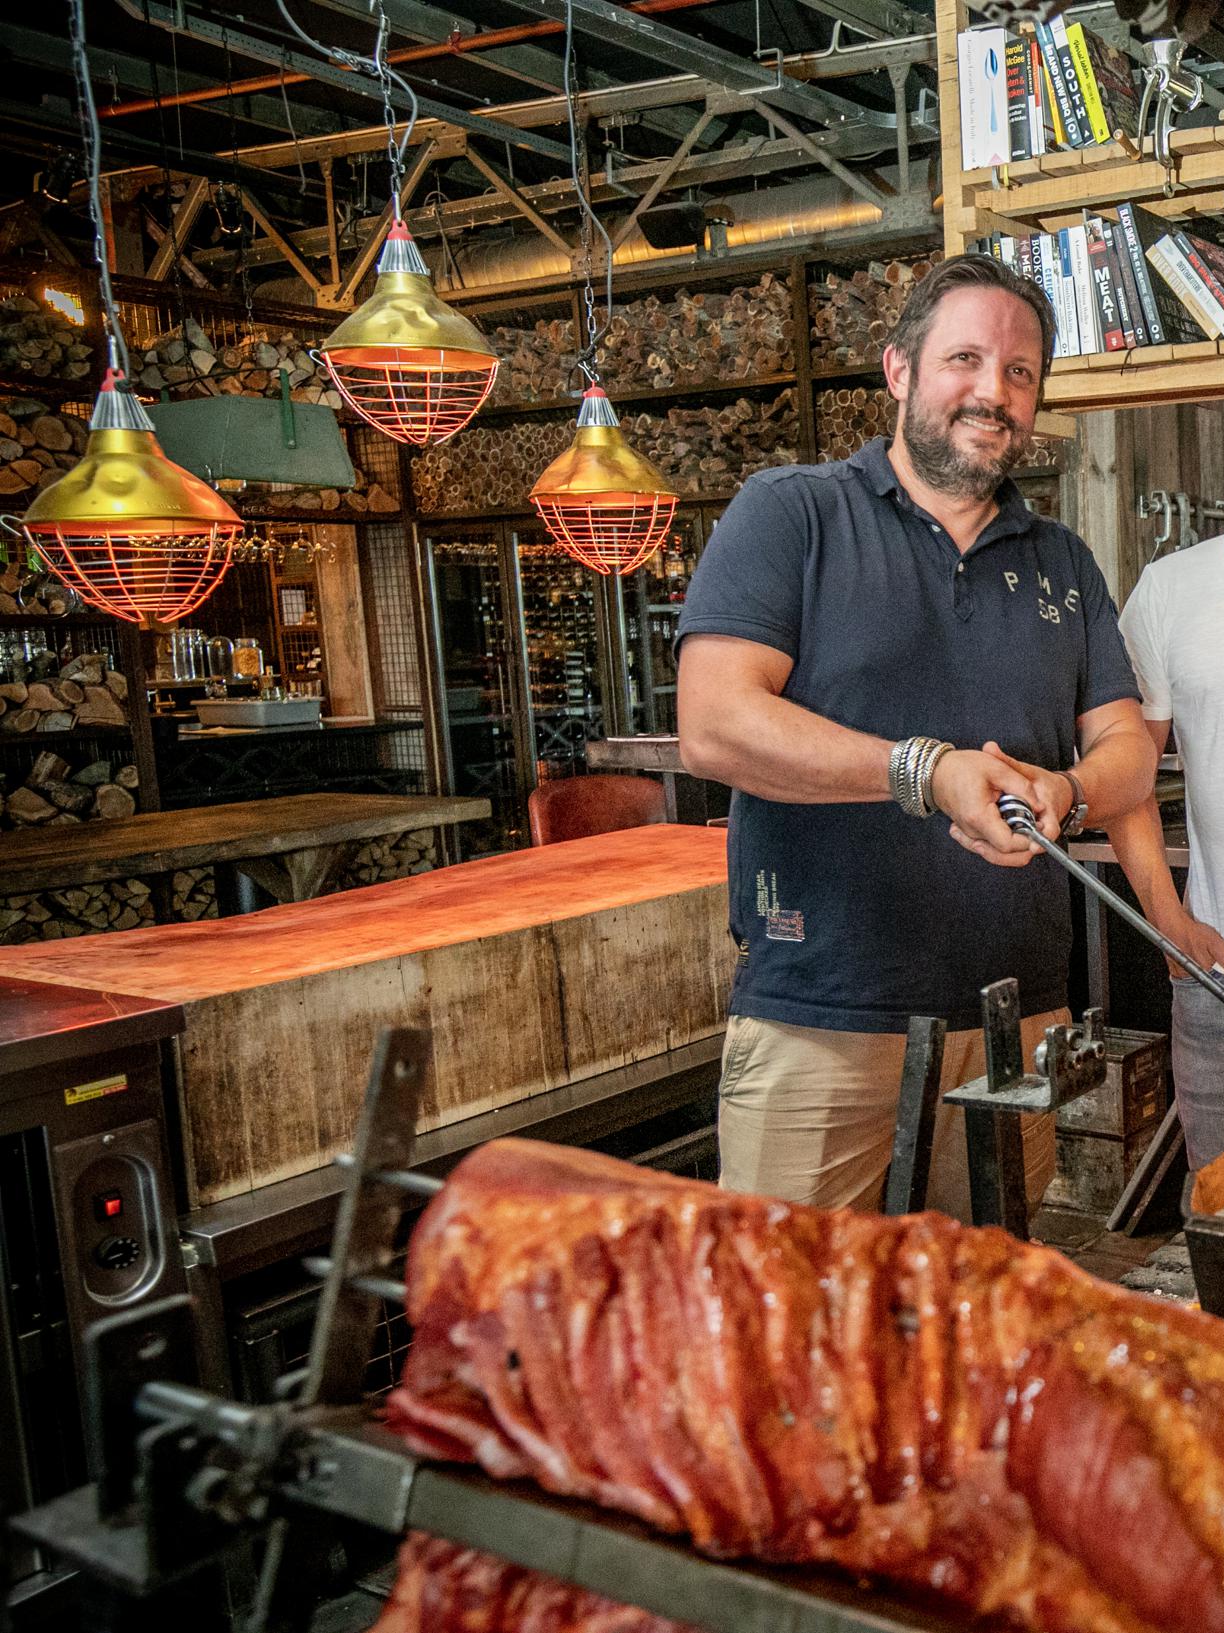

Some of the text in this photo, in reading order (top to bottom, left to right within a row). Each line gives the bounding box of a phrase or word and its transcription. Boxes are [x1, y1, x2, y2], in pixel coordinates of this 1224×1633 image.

[1044, 44, 1071, 118] BRAND NEW BBQ
[1062, 56, 1086, 120] SOUTH
[1032, 240, 1042, 273] BOOK
[1094, 266, 1114, 322] MEAT
[1117, 287, 1129, 322] BUTCHERY
